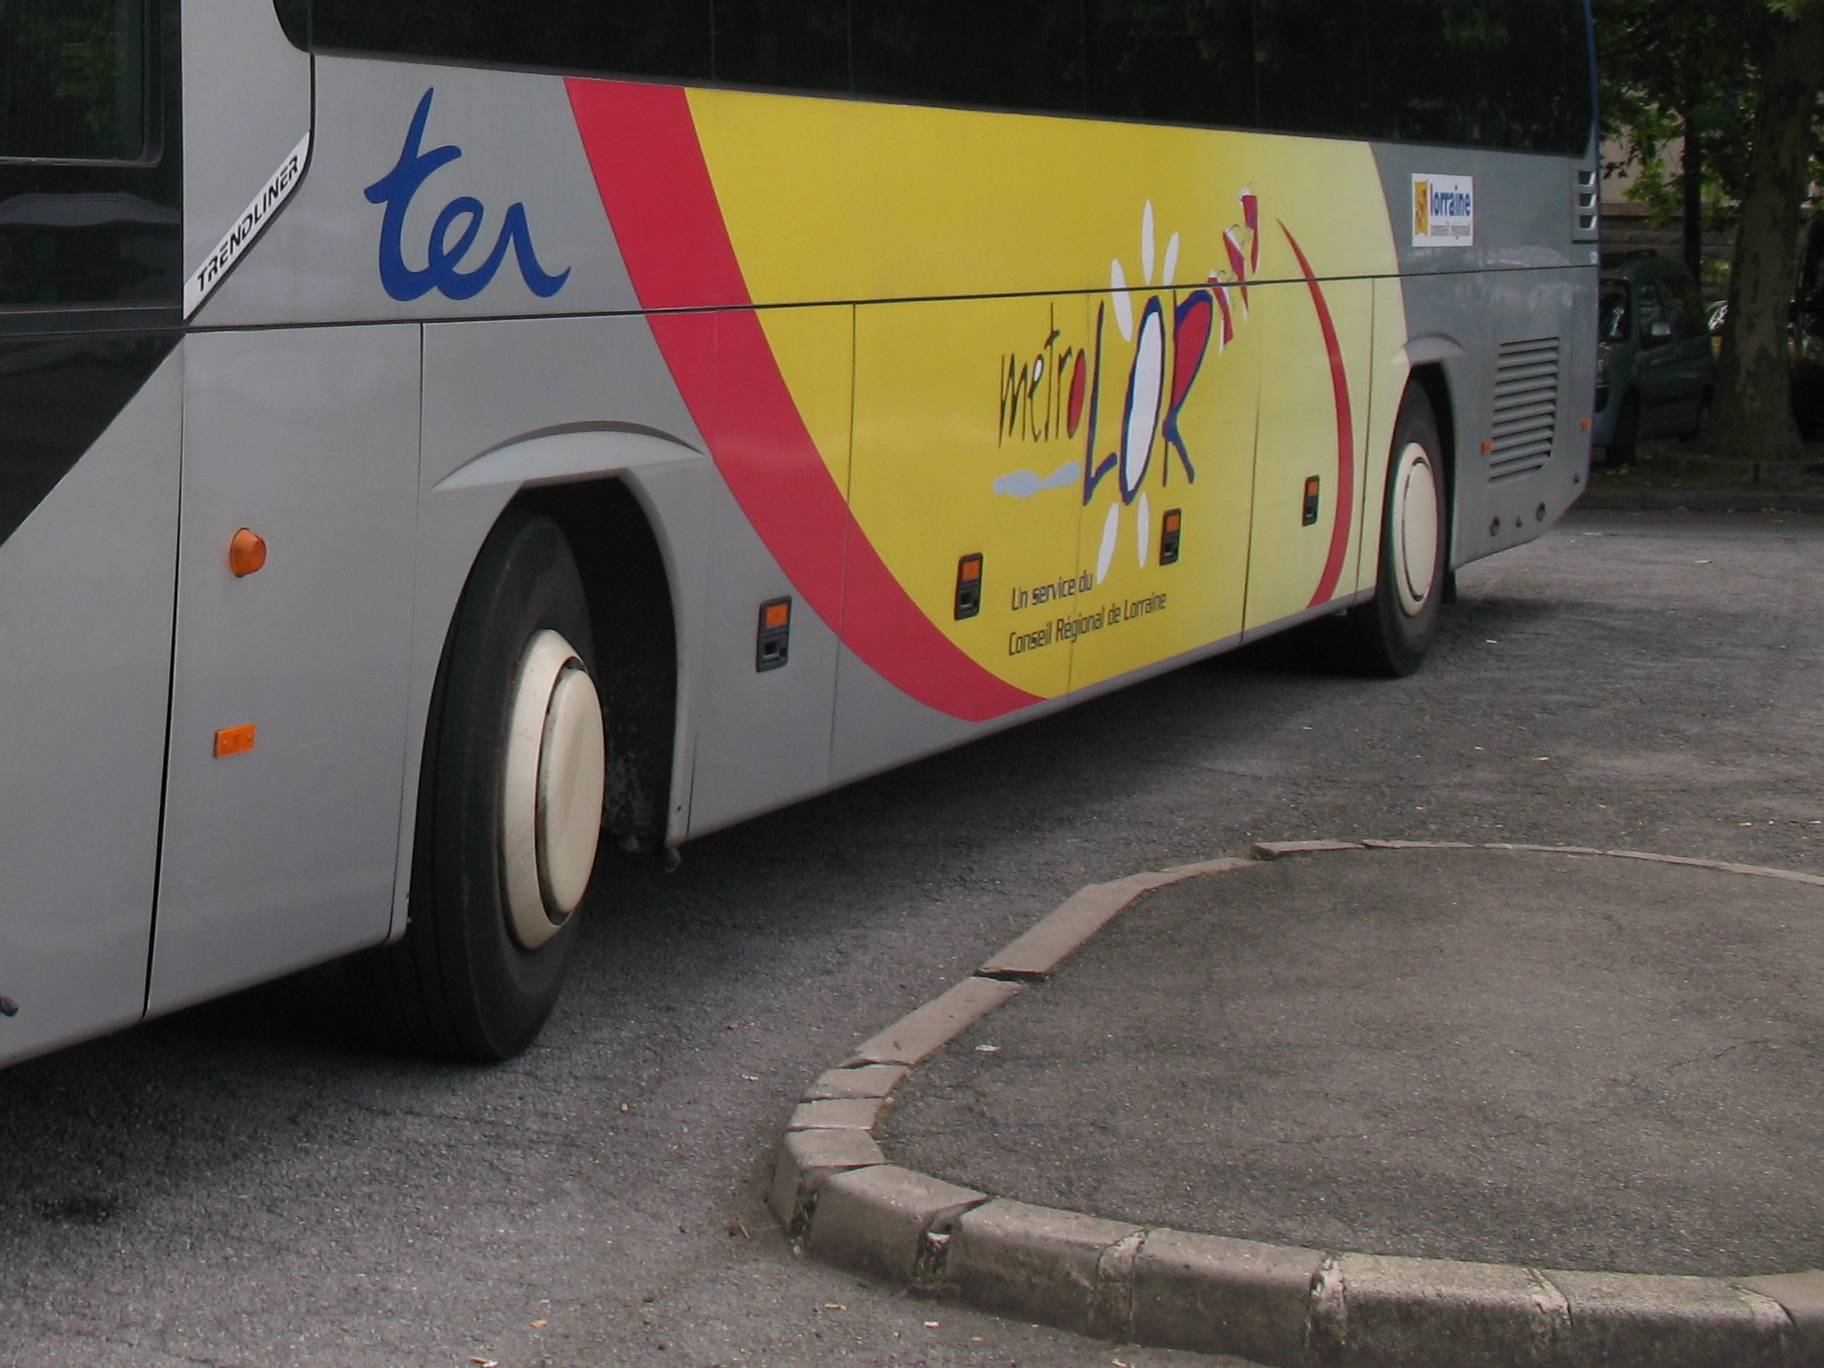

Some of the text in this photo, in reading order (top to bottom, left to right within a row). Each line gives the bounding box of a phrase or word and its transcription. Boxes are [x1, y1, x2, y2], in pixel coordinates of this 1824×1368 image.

[196, 153, 299, 293] TRENDLINER
[363, 86, 572, 302] ter
[1430, 183, 1471, 217] lorraine
[1011, 569, 1093, 611] Un service du
[1008, 591, 1167, 656] Conseil Régional de Lorraine
